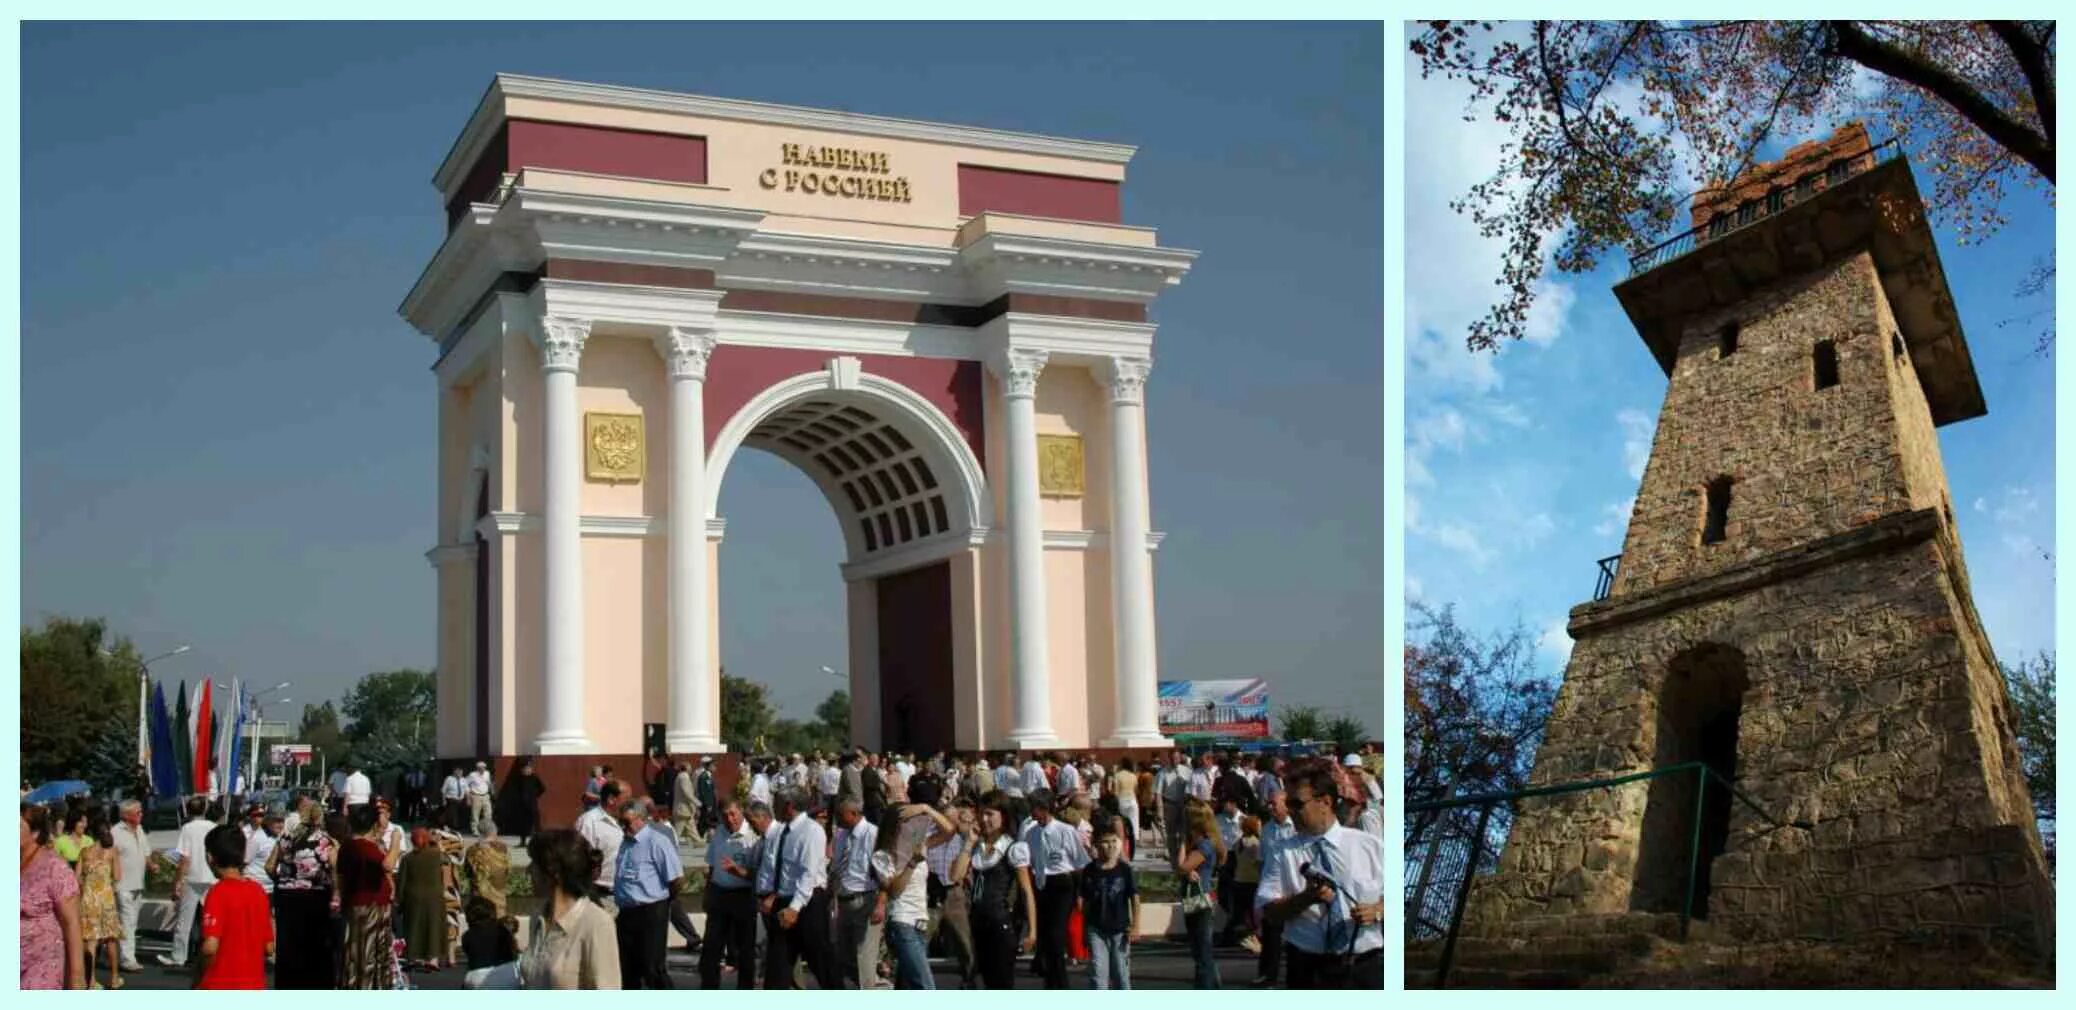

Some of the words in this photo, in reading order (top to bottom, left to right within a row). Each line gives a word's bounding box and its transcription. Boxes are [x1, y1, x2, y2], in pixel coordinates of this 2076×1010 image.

[782, 143, 891, 174] НАВЕКИ
[759, 168, 778, 190] С
[785, 170, 912, 203] РОССИЕЙ
